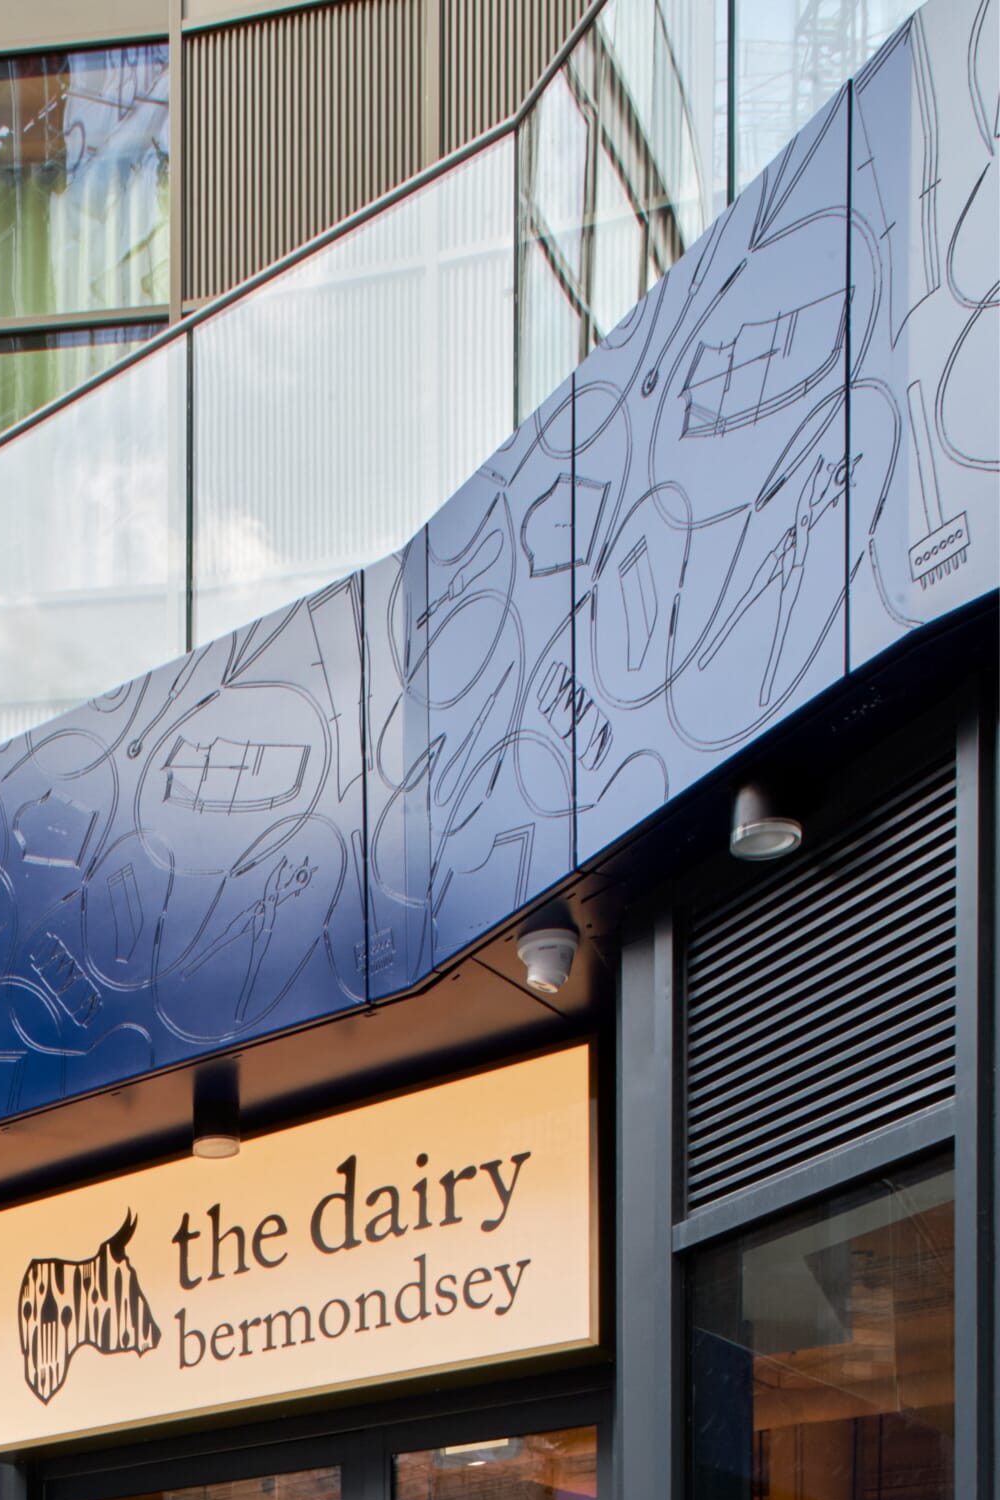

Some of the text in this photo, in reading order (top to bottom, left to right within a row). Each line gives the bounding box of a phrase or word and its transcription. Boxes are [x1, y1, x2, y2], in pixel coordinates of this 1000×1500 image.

[171, 1152, 532, 1291] the dairy
[174, 1253, 532, 1369] bermondsey
